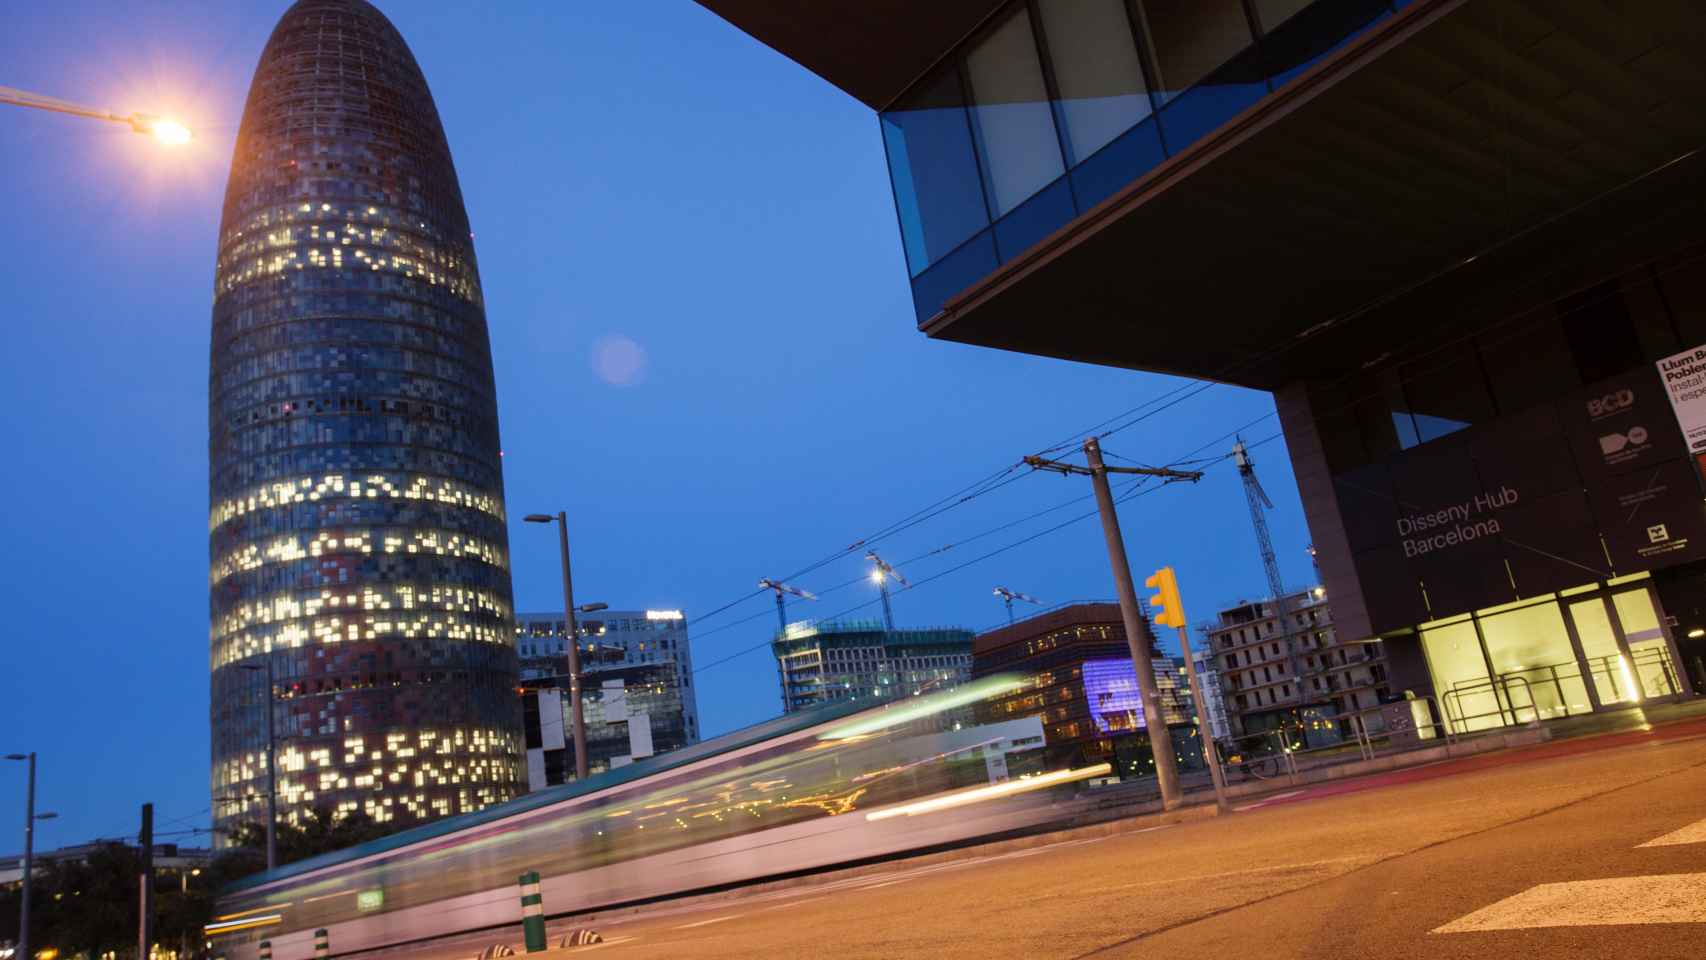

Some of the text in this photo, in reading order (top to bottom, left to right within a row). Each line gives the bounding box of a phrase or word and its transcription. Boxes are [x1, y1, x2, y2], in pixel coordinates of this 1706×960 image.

[1662, 356, 1694, 371] Llum
[1397, 485, 1518, 536] Disseny Hub
[1403, 519, 1500, 558] Barcelona
